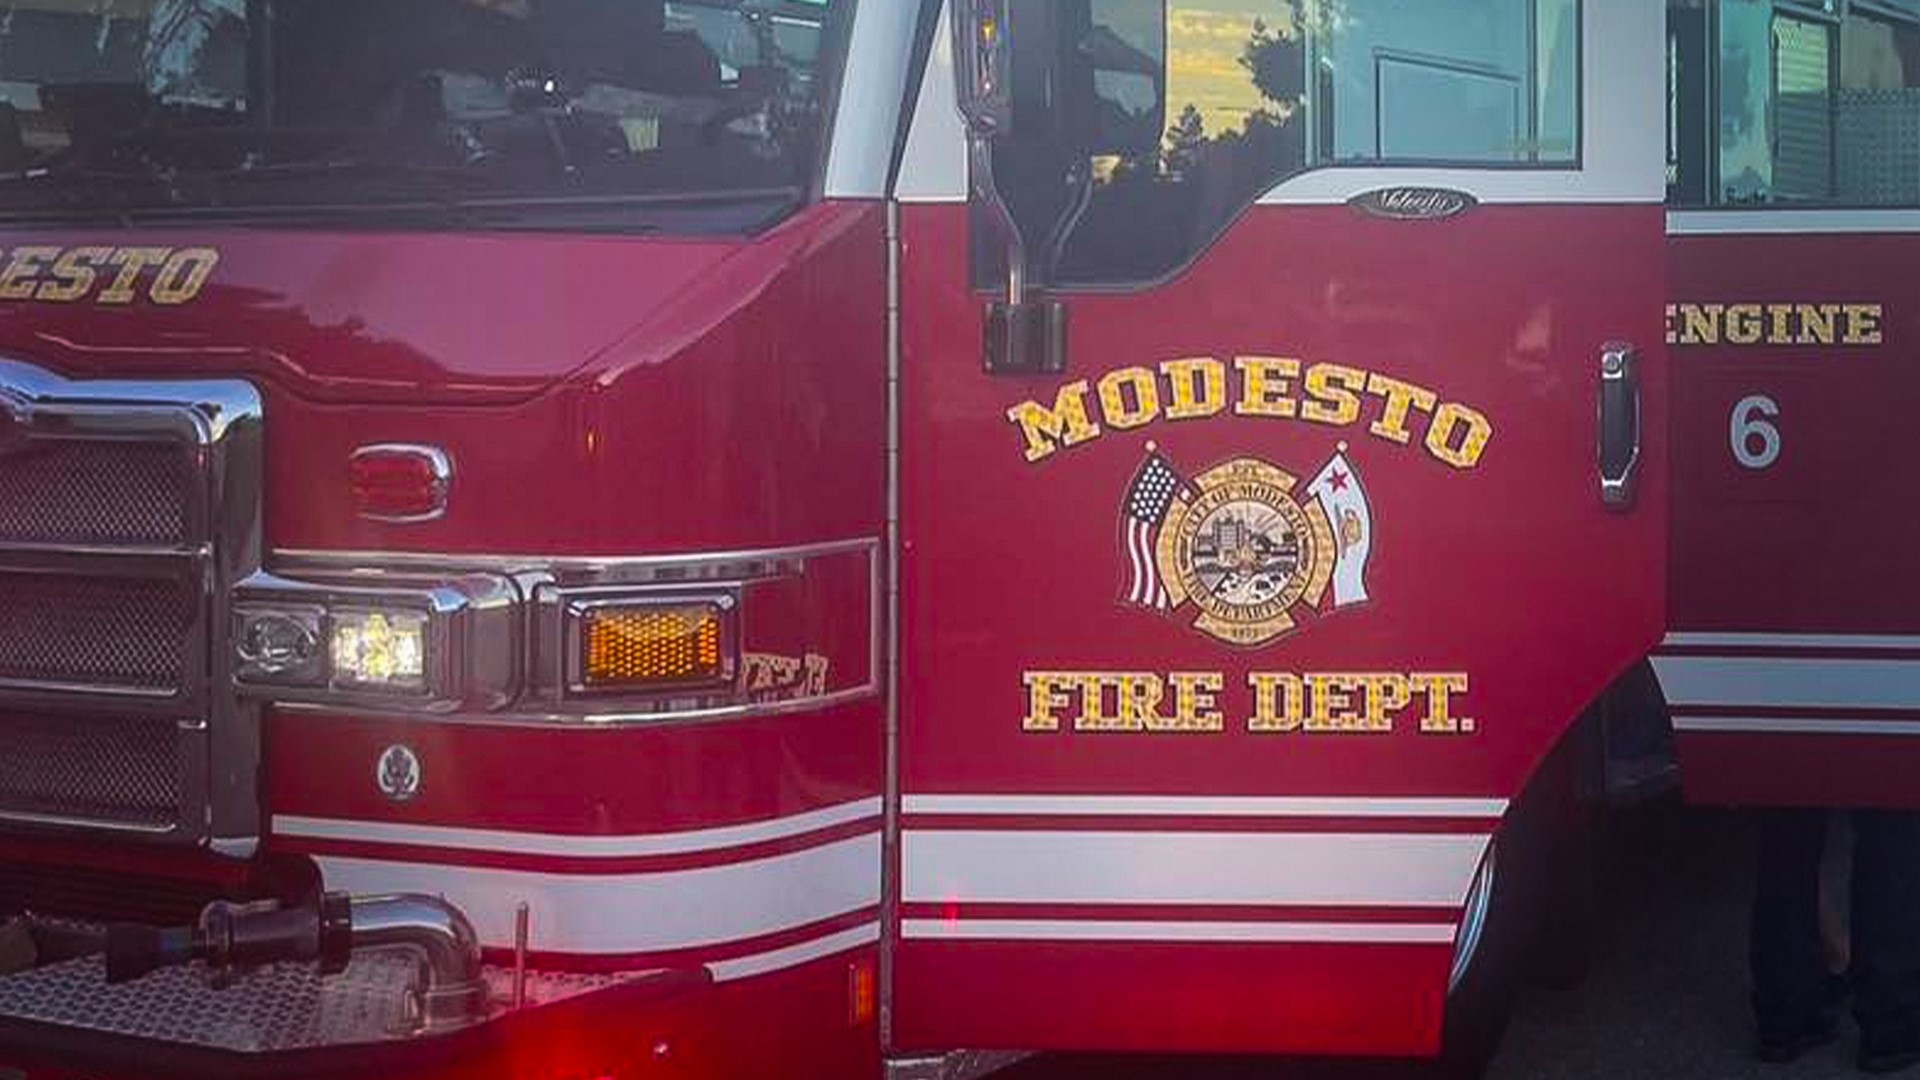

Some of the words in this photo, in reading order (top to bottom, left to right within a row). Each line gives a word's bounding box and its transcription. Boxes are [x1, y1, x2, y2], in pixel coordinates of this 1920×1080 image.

[0, 246, 219, 304] ESTO
[1666, 303, 1882, 344] NGINE
[1007, 356, 1494, 468] MODESTO
[1730, 395, 1780, 468] 6
[1240, 484, 1307, 538] MODESTO
[1021, 671, 1224, 732] FIRE
[1247, 671, 1475, 732] DEPT.
